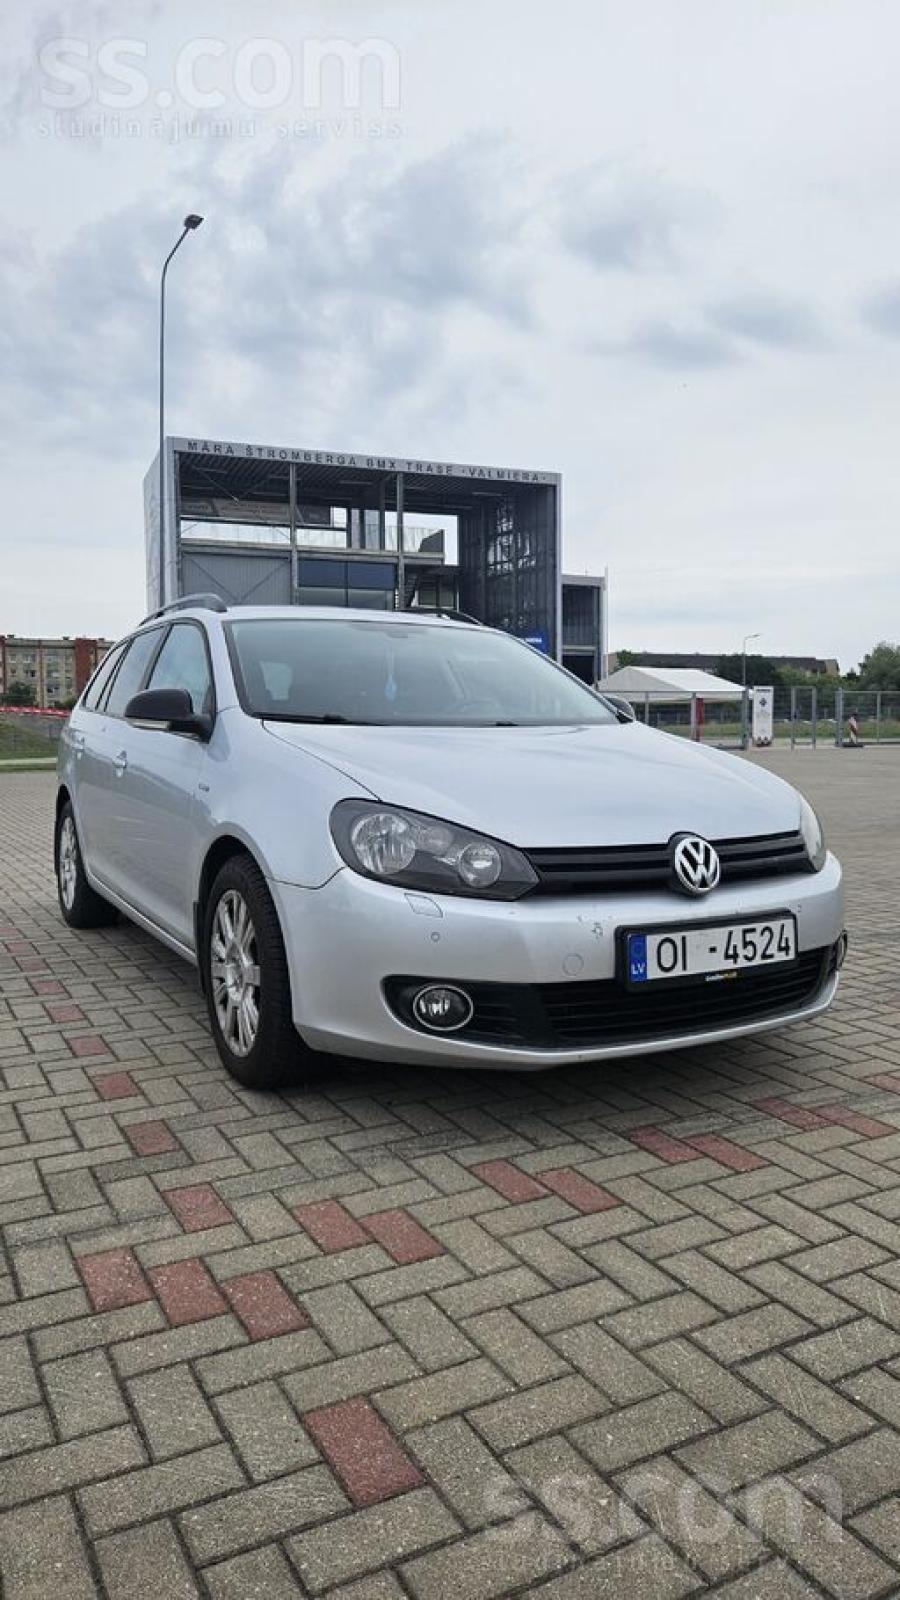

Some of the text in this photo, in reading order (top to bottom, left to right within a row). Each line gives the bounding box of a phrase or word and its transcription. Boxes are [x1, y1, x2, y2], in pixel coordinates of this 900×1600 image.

[366, 459, 397, 470] BMX
[406, 461, 453, 473] TRASE
[631, 961, 646, 976] LV
